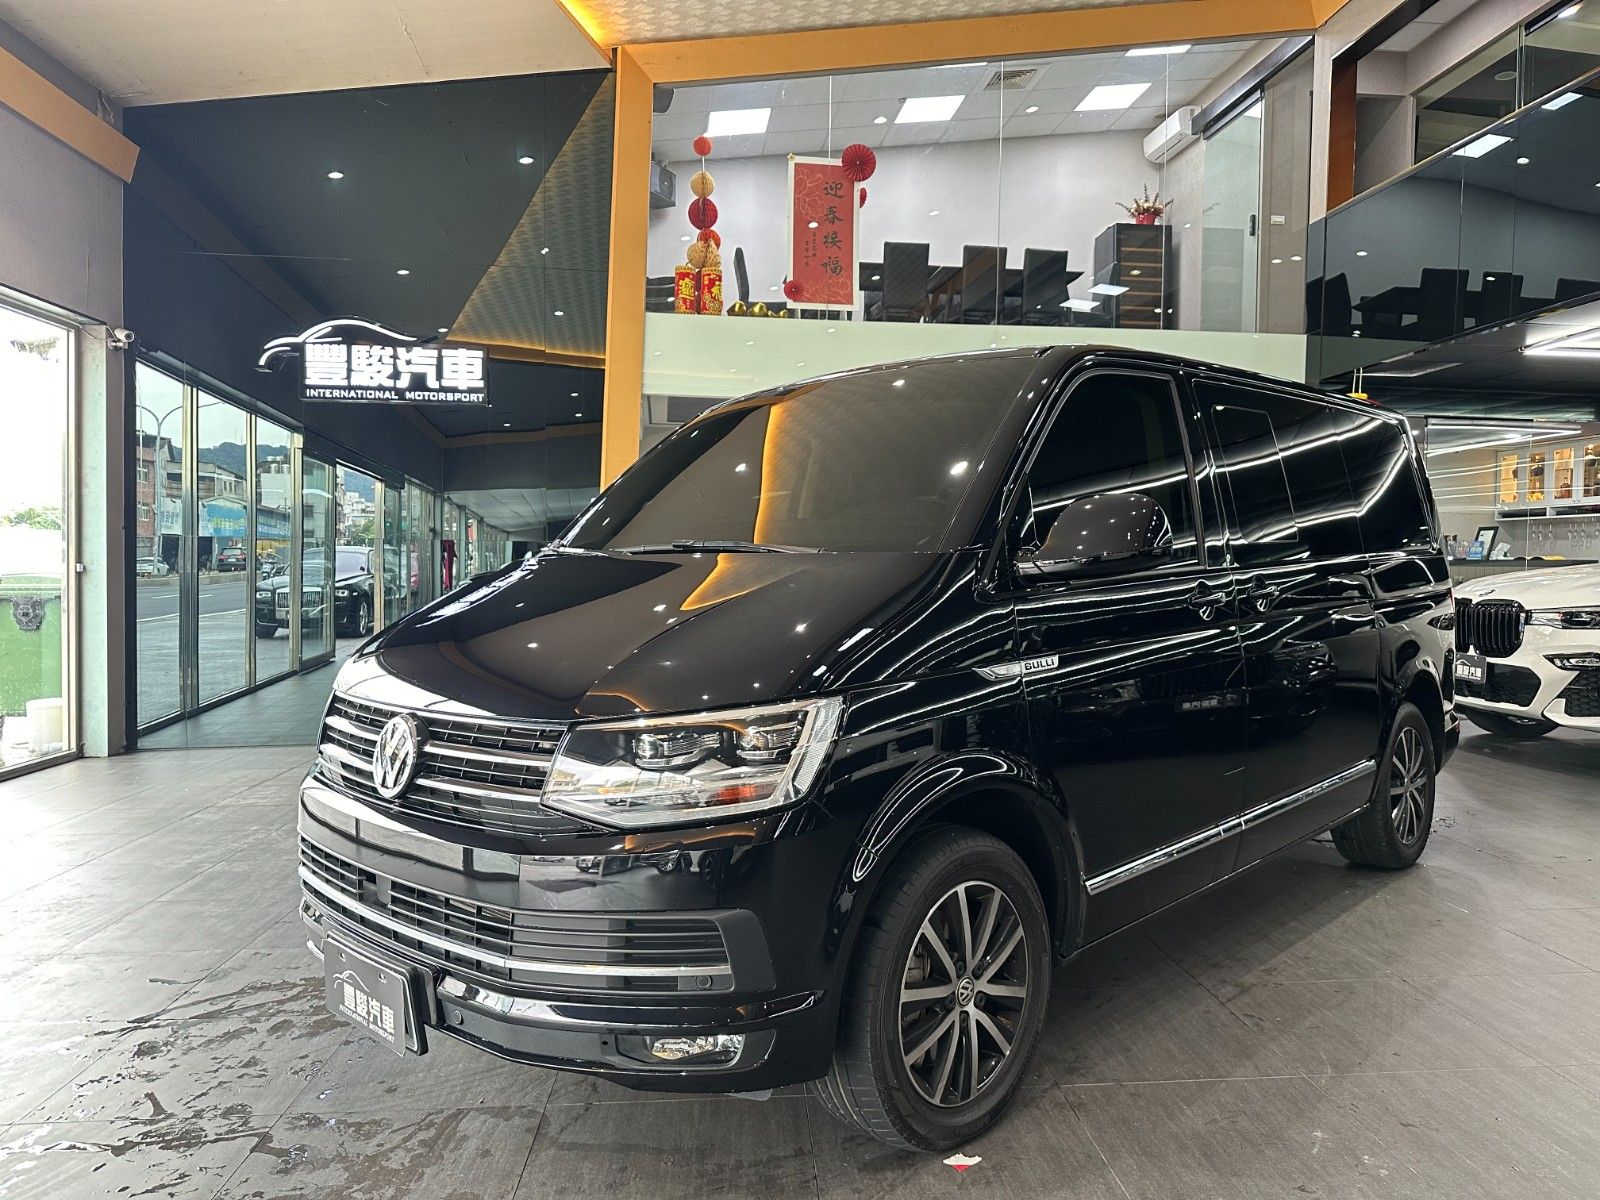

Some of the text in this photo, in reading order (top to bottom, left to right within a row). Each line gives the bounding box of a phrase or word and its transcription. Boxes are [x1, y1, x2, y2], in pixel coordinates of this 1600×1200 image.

[821, 181, 845, 276] 迎春接福
[304, 343, 484, 389] 豐駿汽車
[306, 388, 484, 401] INTERNATIONAL MOTORSPORT
[1024, 659, 1055, 671] BULLI
